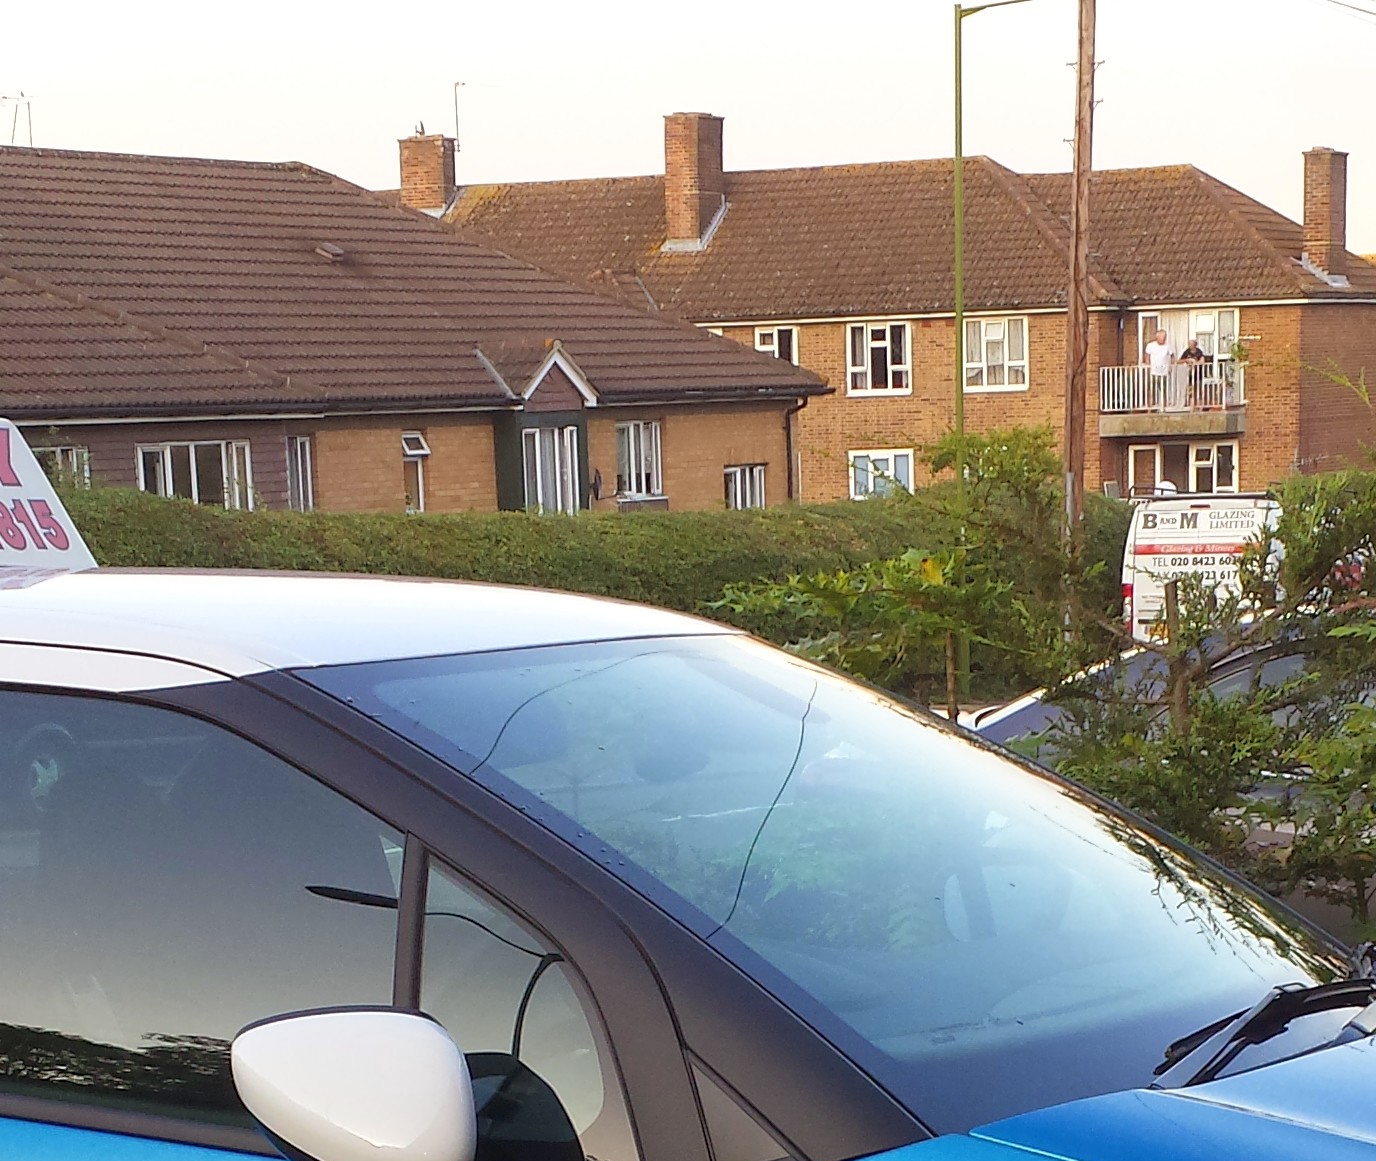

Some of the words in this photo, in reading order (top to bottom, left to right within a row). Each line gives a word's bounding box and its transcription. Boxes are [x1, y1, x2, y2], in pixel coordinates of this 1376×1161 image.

[1209, 511, 1255, 520] GLAZING
[1142, 513, 1157, 529] B
[1159, 517, 1177, 525] AND
[1180, 513, 1199, 529] M
[1209, 520, 1254, 529] LIMITED
[1152, 557, 1168, 567] TEL
[1171, 556, 1189, 566] 020
[1192, 556, 1216, 566] 8423
